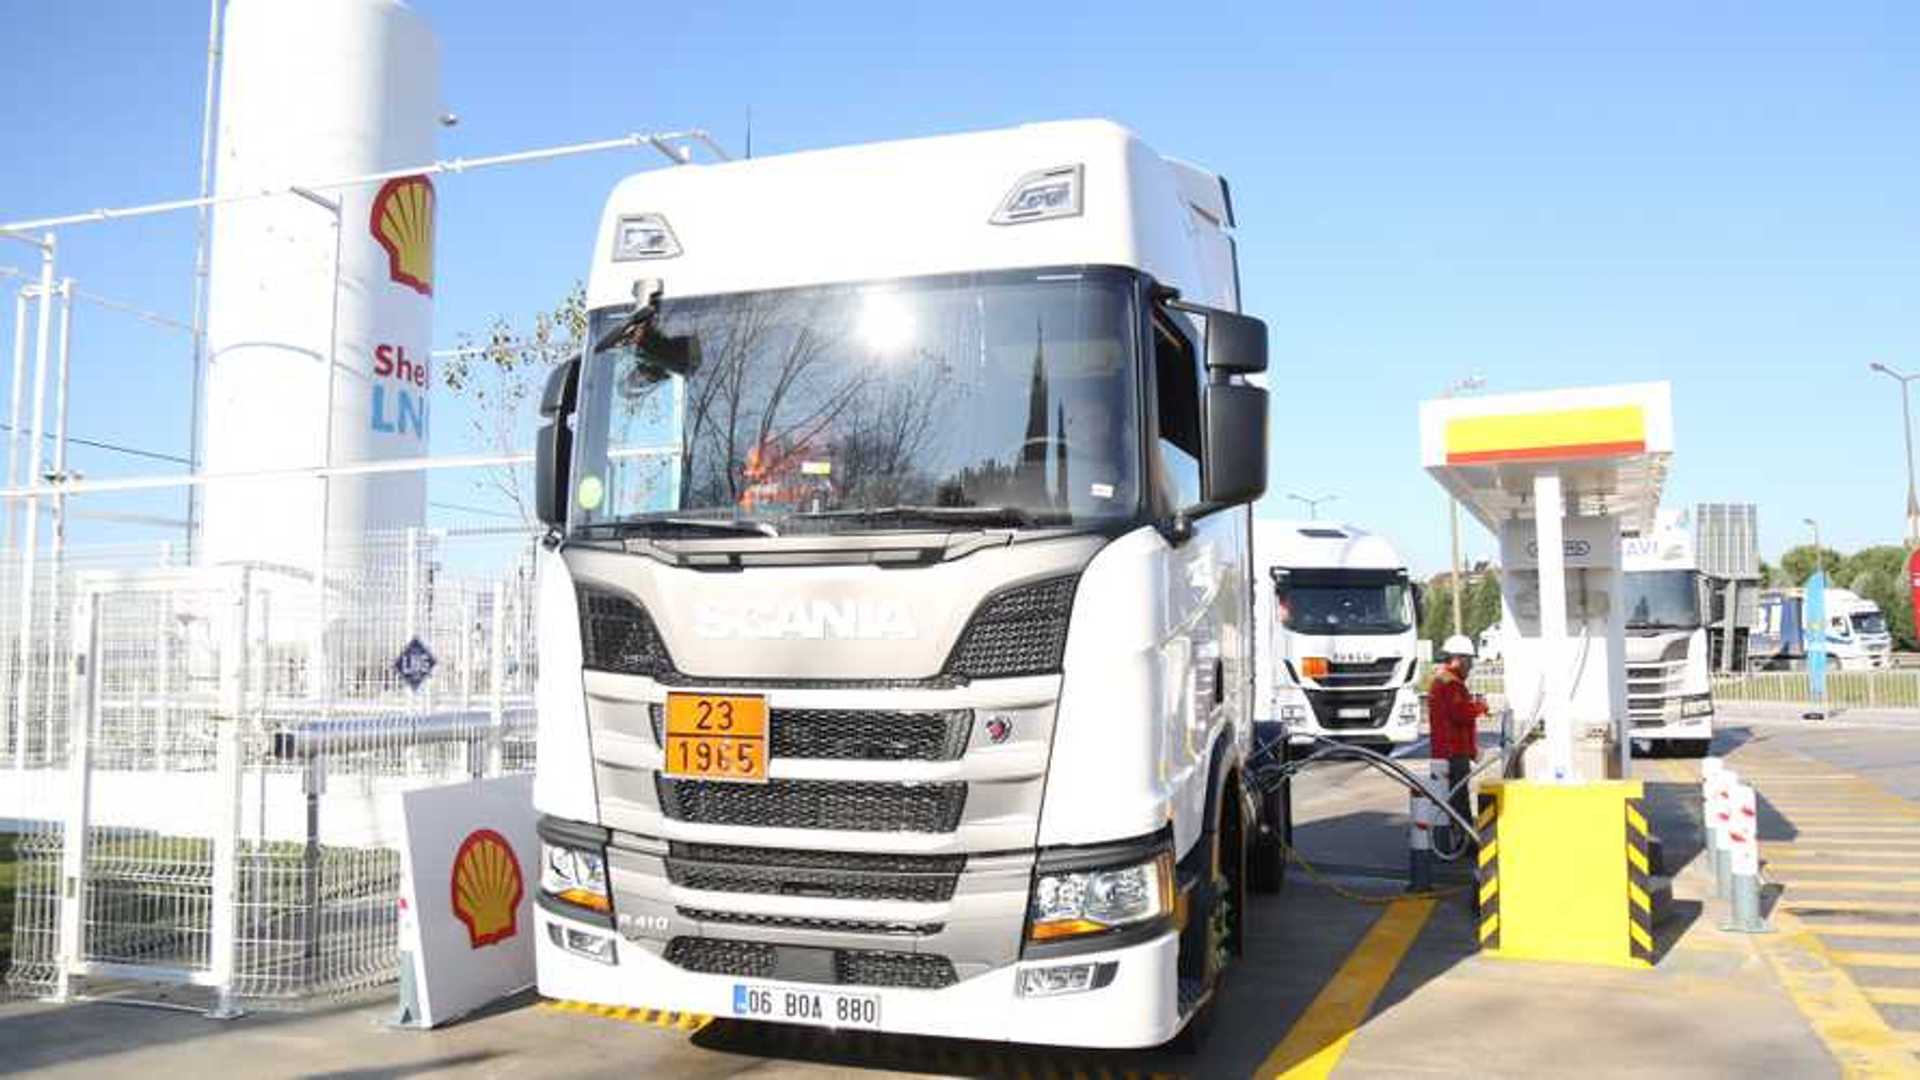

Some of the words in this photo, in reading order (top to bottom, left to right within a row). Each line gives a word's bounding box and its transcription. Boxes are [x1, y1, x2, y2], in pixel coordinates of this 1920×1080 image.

[373, 343, 430, 391] Shel
[371, 382, 430, 441] LN
[696, 600, 919, 640] SCANIA
[696, 700, 734, 731] 23
[679, 741, 755, 774] 1965
[749, 989, 772, 1014] 06
[836, 996, 876, 1023] 880
